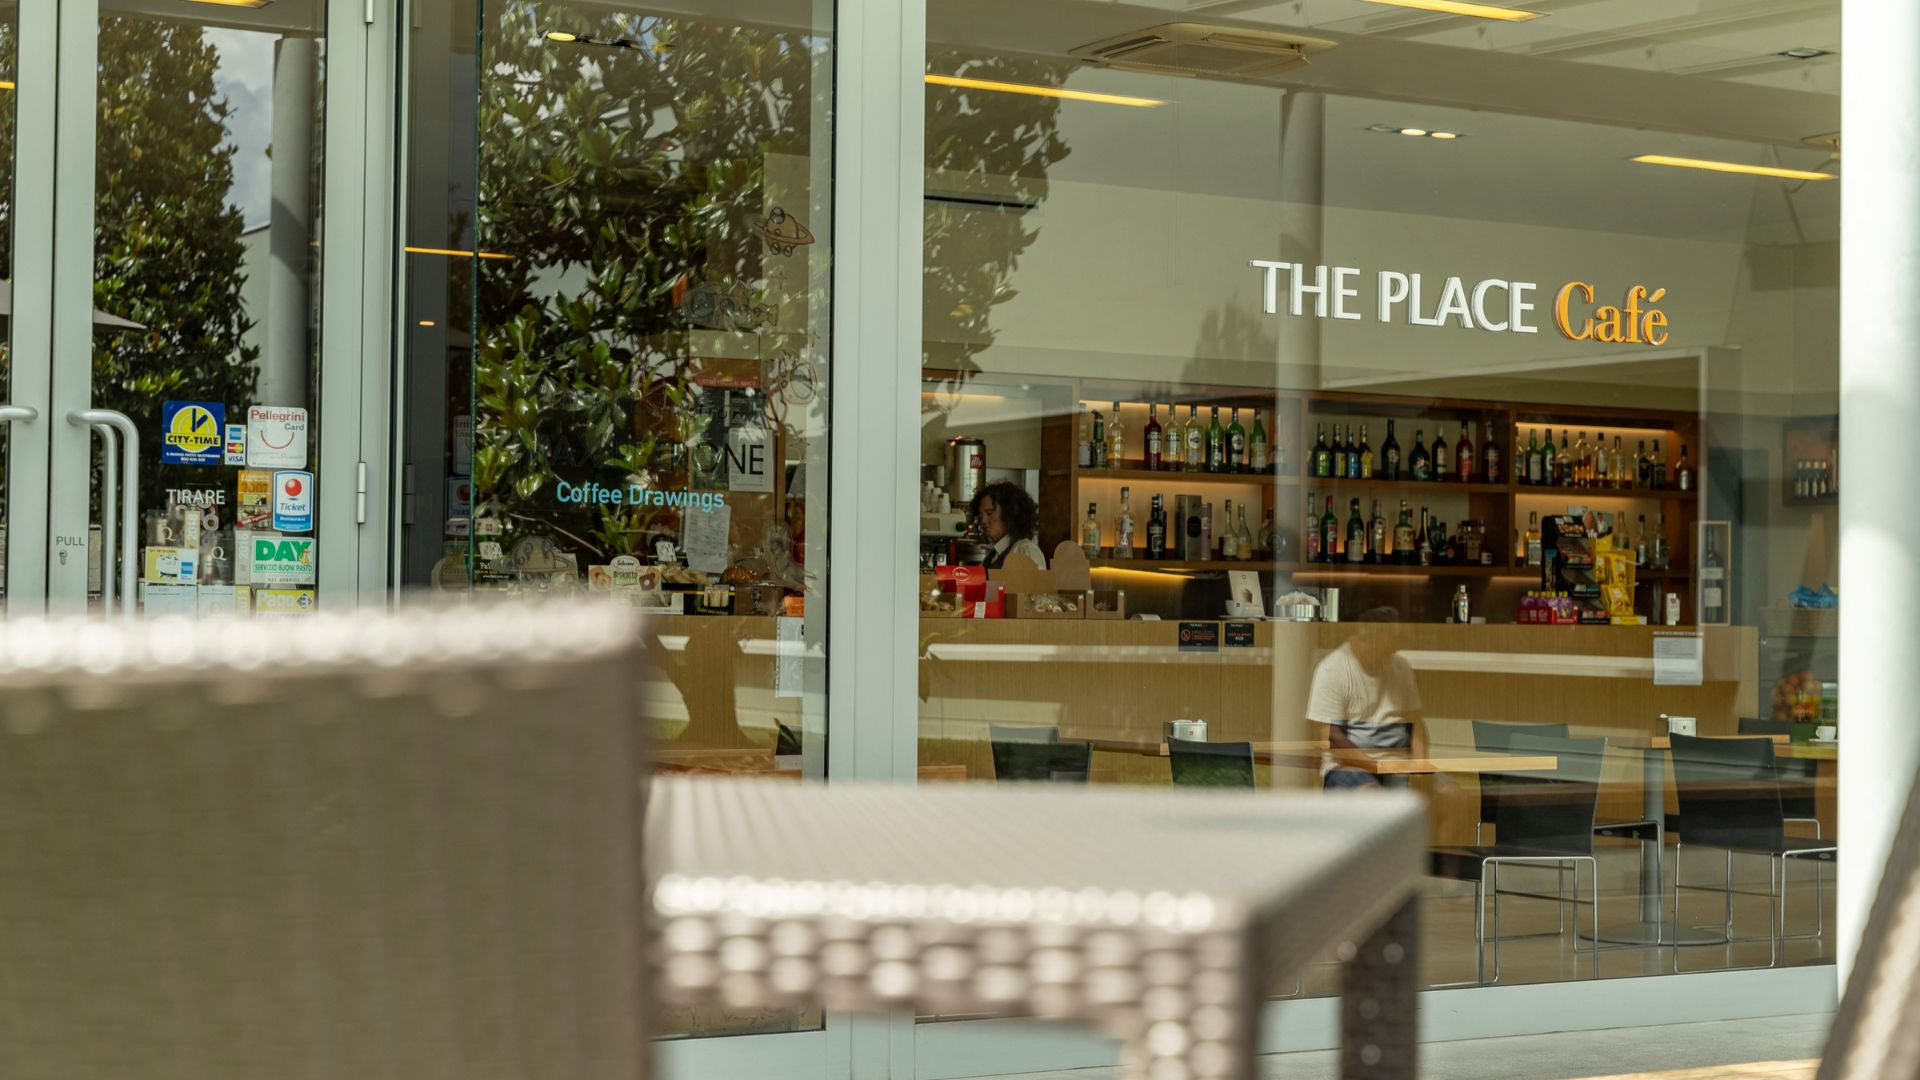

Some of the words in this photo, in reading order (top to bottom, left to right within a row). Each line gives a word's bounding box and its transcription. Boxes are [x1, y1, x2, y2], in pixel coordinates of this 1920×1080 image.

[1250, 259, 1361, 320] THE
[1378, 271, 1538, 332] PLACE
[1553, 281, 1669, 346] Café
[251, 409, 305, 422] Pellegrini
[284, 423, 305, 431] Card
[167, 434, 219, 446] CITY-TIME
[228, 455, 244, 463] VISA
[165, 488, 226, 504] TIRARE
[556, 480, 623, 505] Coffee
[629, 484, 725, 513] Drawings
[280, 502, 306, 511] Ticket
[56, 535, 86, 546] PULL
[255, 539, 312, 562] DAY
